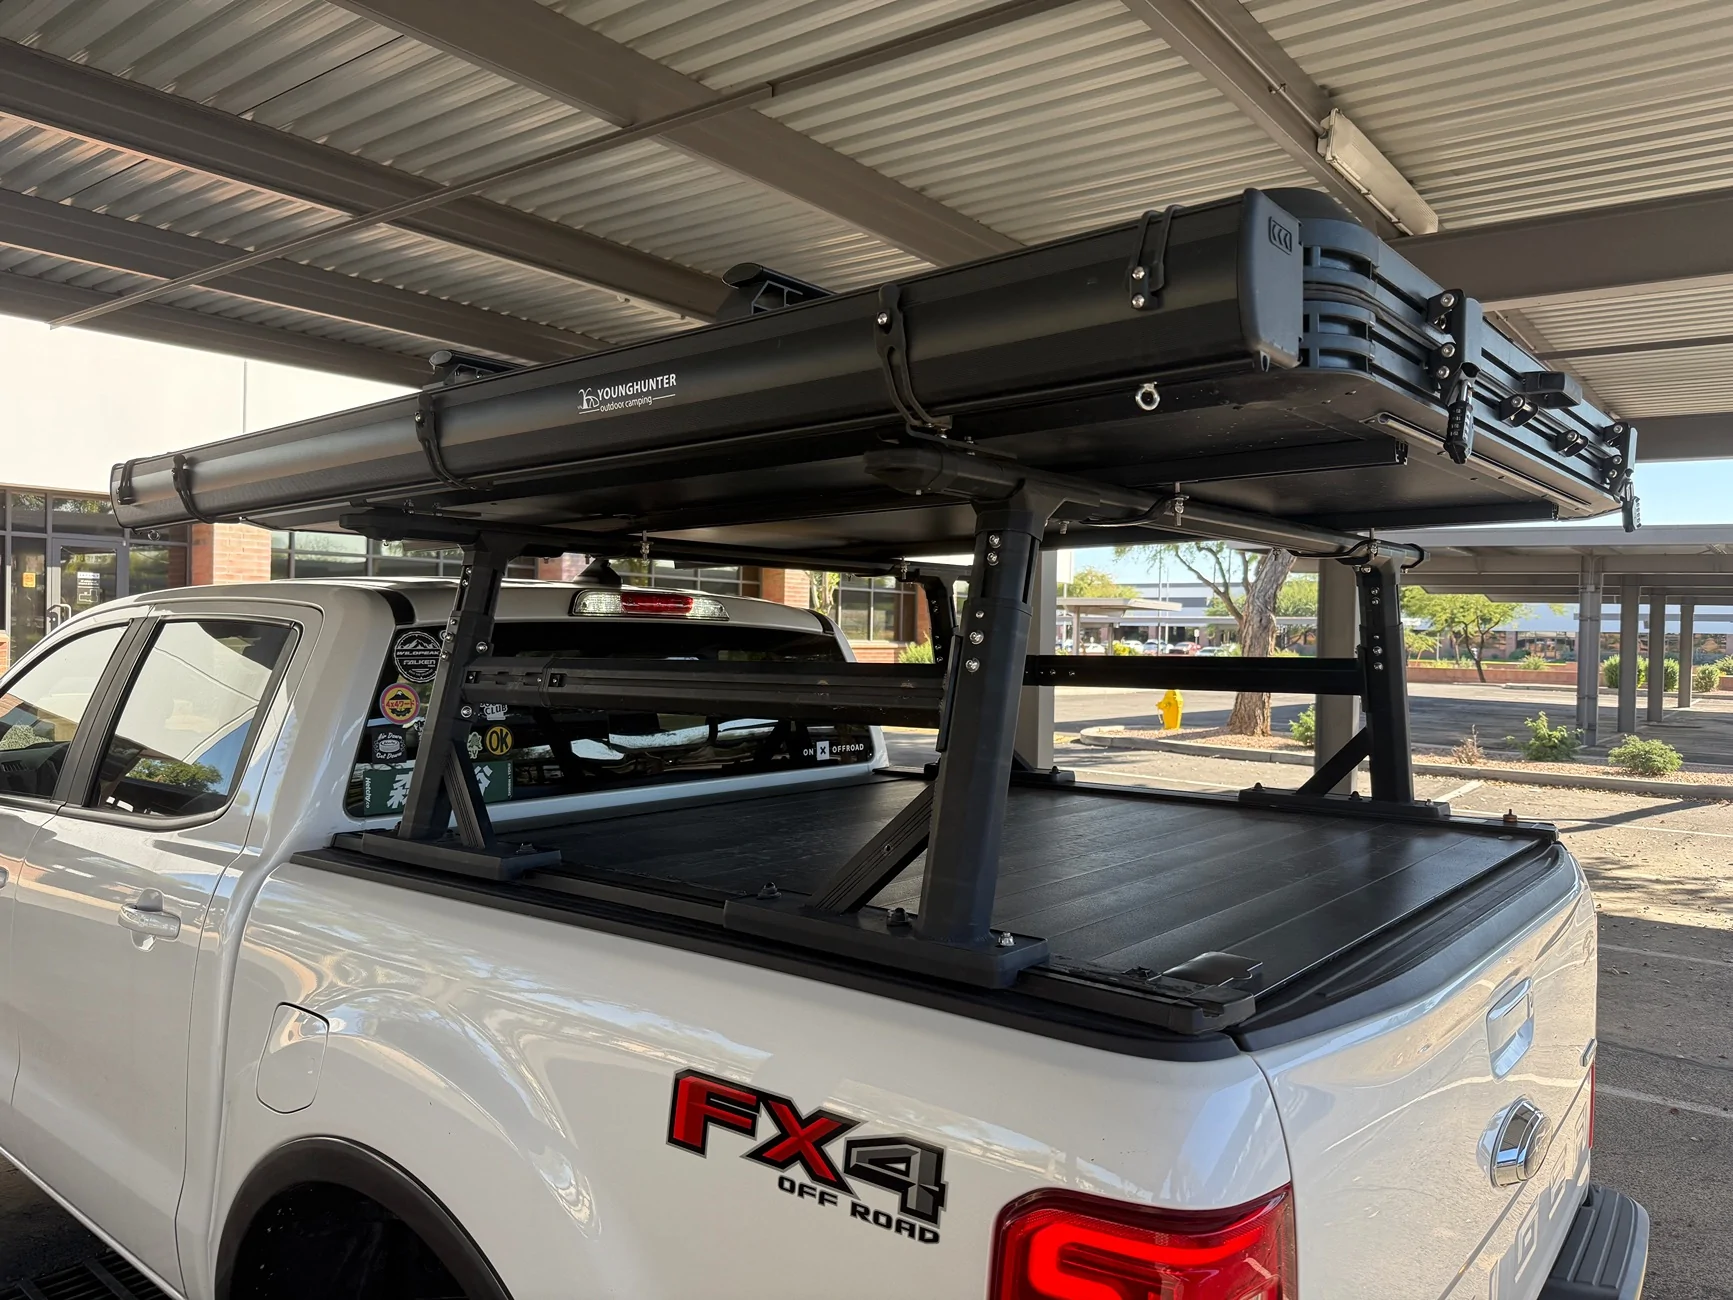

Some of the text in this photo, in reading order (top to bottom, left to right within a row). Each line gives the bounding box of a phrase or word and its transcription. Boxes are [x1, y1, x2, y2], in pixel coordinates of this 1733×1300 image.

[597, 373, 677, 401] YOUNGHUNTER
[600, 395, 652, 413] outdoor camping
[484, 703, 508, 716] CLUB
[489, 728, 509, 753] OK
[803, 748, 814, 756] ON
[832, 743, 865, 753] OFFROAD
[666, 1066, 949, 1229] FX4
[777, 1174, 941, 1245] OFF ROAD
